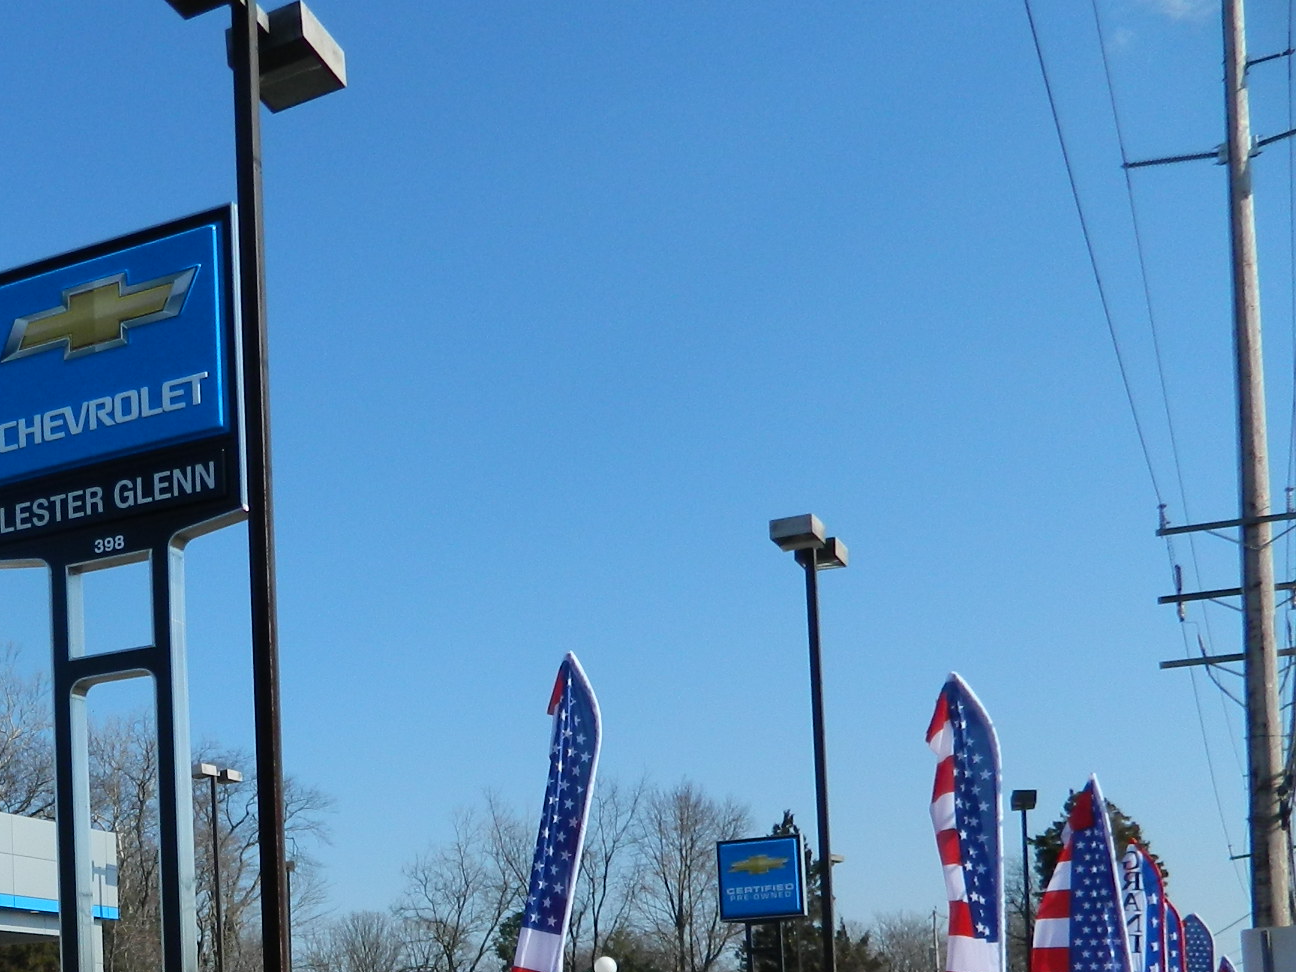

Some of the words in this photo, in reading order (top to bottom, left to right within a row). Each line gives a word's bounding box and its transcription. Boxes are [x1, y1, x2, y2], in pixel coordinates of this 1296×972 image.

[0, 486, 104, 534] LESTER
[114, 461, 216, 509] GLENN
[94, 535, 125, 553] 398
[726, 882, 795, 895] CERTIFIED
